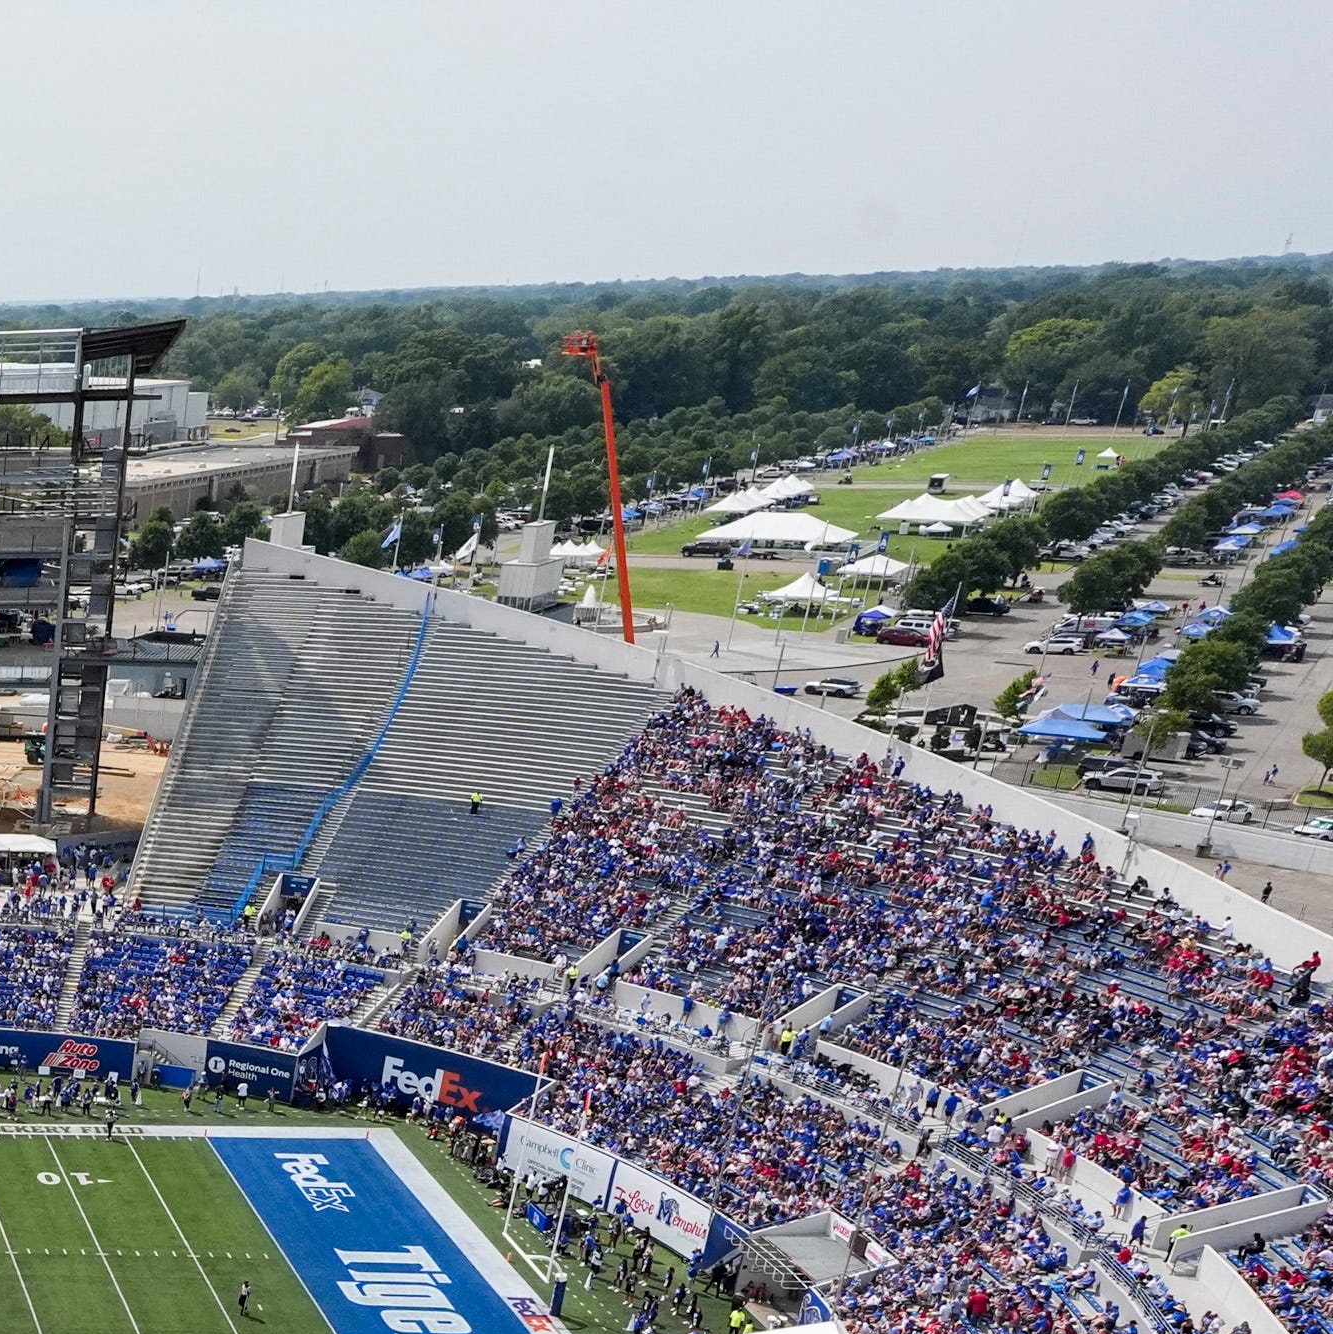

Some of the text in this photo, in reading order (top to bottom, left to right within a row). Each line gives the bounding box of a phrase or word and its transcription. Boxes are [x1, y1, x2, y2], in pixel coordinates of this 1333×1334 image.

[57, 1039, 98, 1056] Auto
[57, 1054, 101, 1071] Zone
[228, 1059, 290, 1080] Regional One
[228, 1068, 258, 1082] Health
[382, 1056, 483, 1112] FedEx
[520, 1135, 598, 1176] Campbell Clinic
[36, 1171, 94, 1186] 10
[274, 1152, 356, 1212] FedEx
[614, 1186, 626, 1201] I
[624, 1189, 655, 1215] Love
[507, 1297, 552, 1333] FedEx
